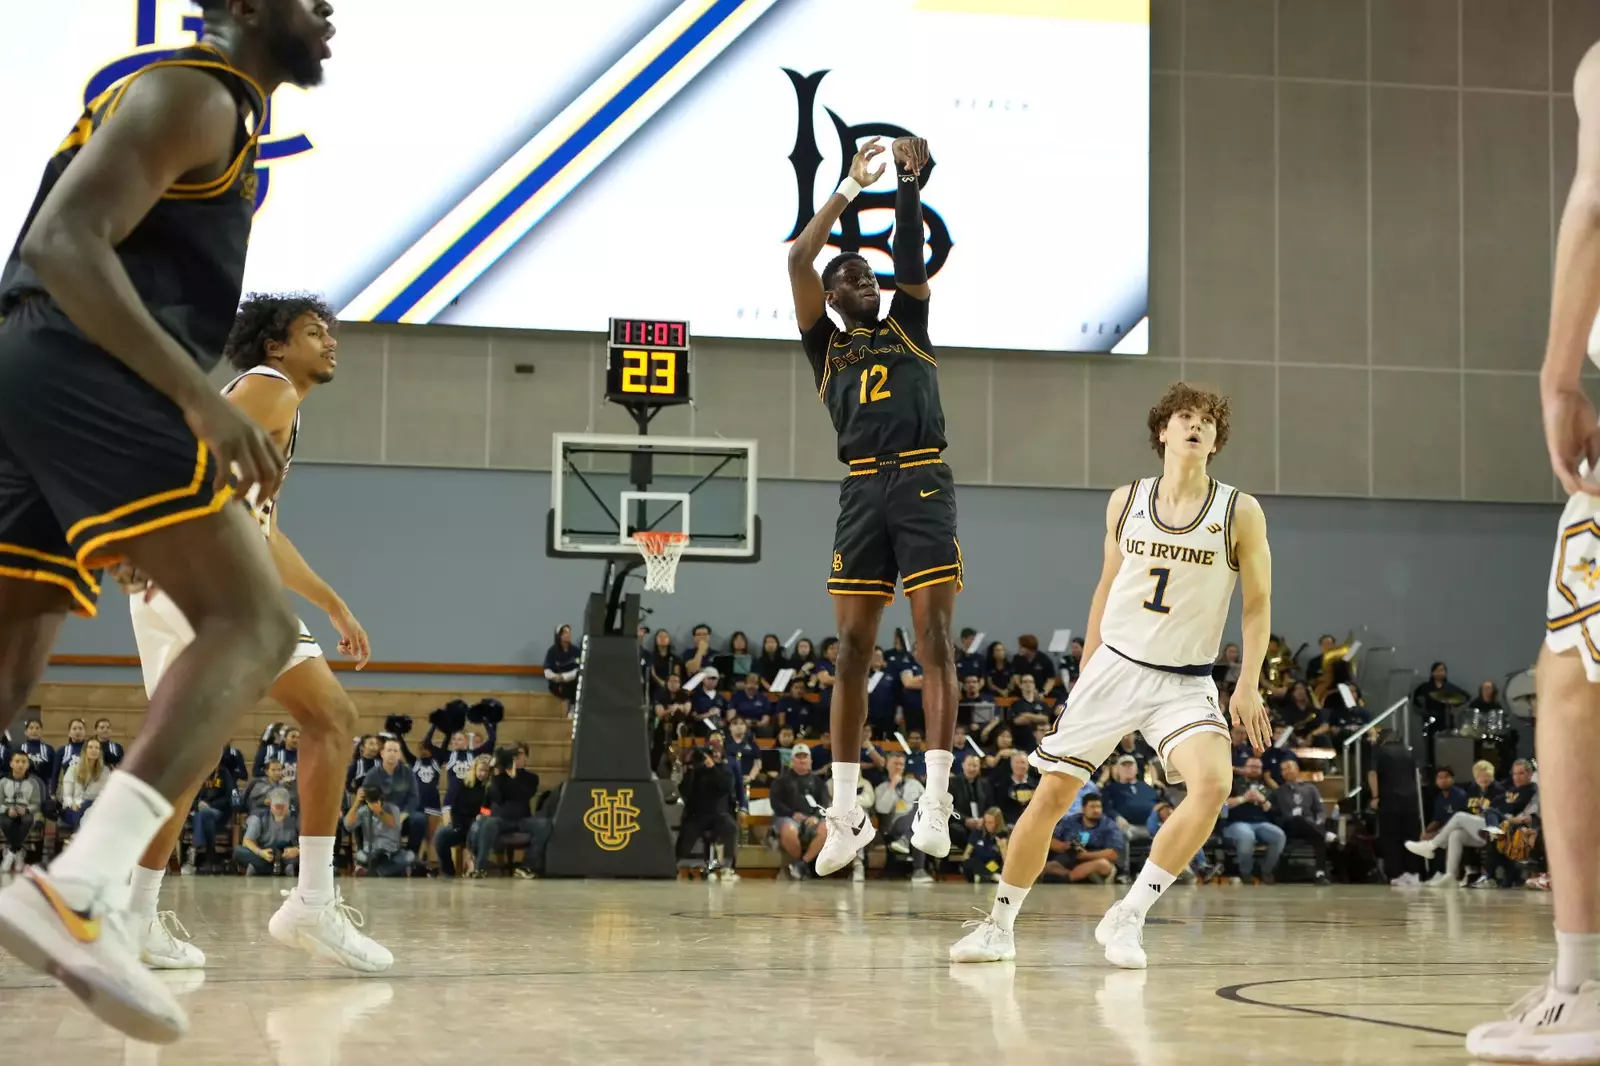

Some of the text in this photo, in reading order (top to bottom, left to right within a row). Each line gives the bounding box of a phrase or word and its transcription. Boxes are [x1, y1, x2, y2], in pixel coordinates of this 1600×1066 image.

[736, 307, 796, 321] BEAC
[625, 321, 683, 346] 11:07
[622, 350, 676, 394] 23
[859, 364, 891, 404] 12
[1126, 538, 1216, 566] UC IRVINE
[1142, 567, 1172, 615] 1
